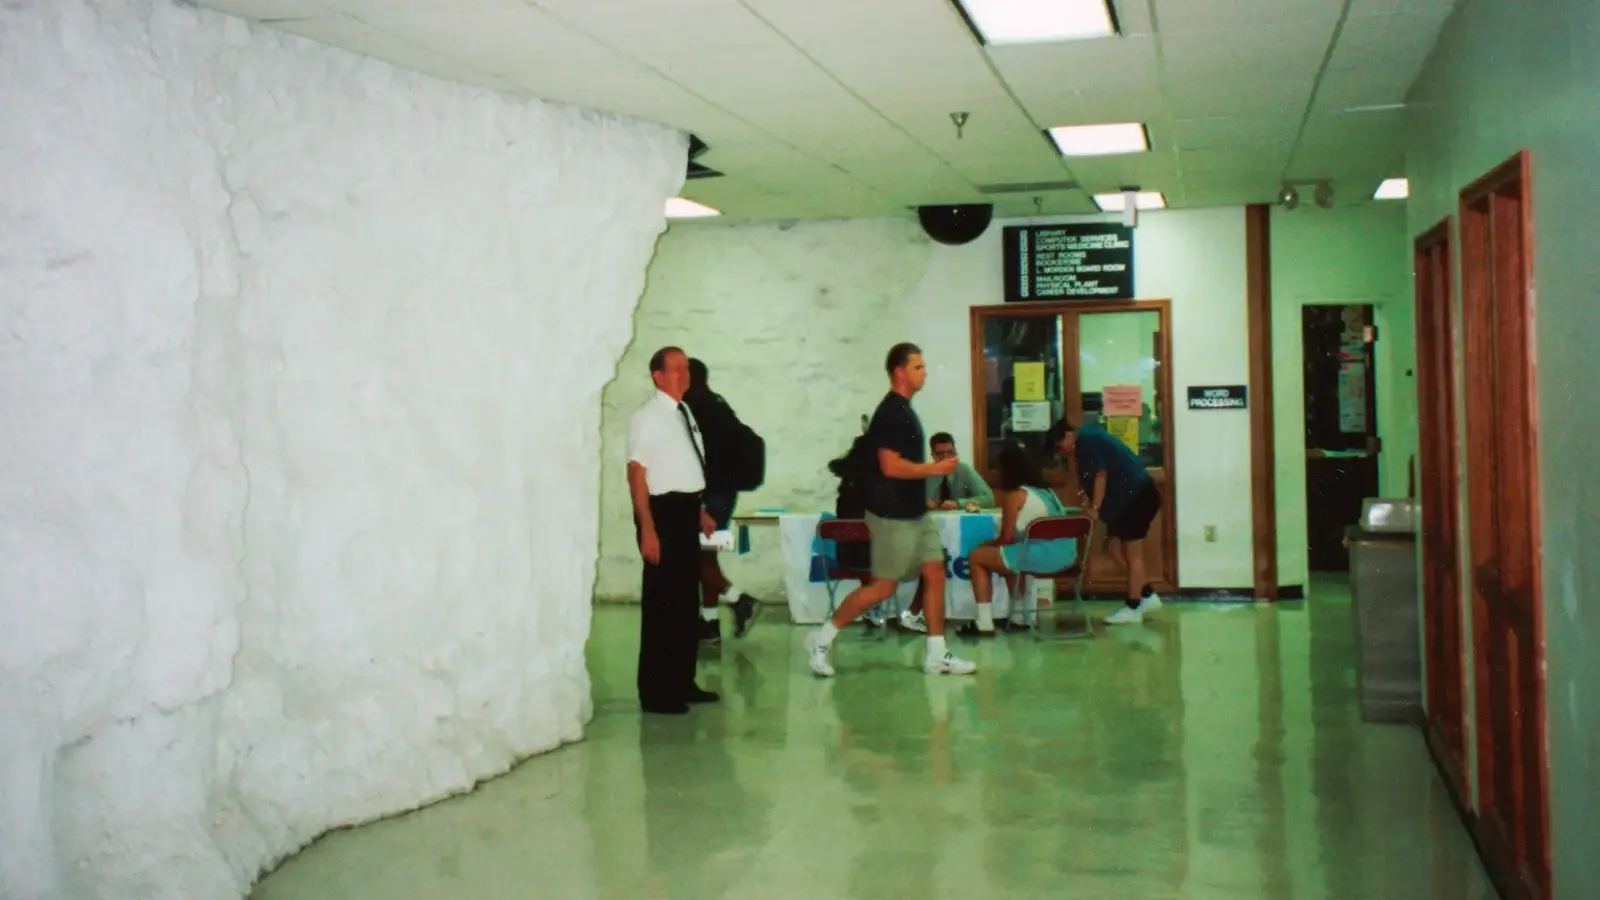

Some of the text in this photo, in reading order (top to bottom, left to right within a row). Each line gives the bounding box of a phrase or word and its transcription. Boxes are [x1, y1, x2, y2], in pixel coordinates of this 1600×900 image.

[1080, 234, 1118, 242] SERVICES
[1036, 240, 1129, 251] SPORTS MEDICINE CLINIC
[1058, 251, 1086, 259] ROOMS
[1074, 280, 1098, 288] PLANT
[1036, 286, 1118, 296] CAREER DEVELOPMENT
[1203, 389, 1229, 397] WORD
[1190, 398, 1244, 407] PROCESSING
